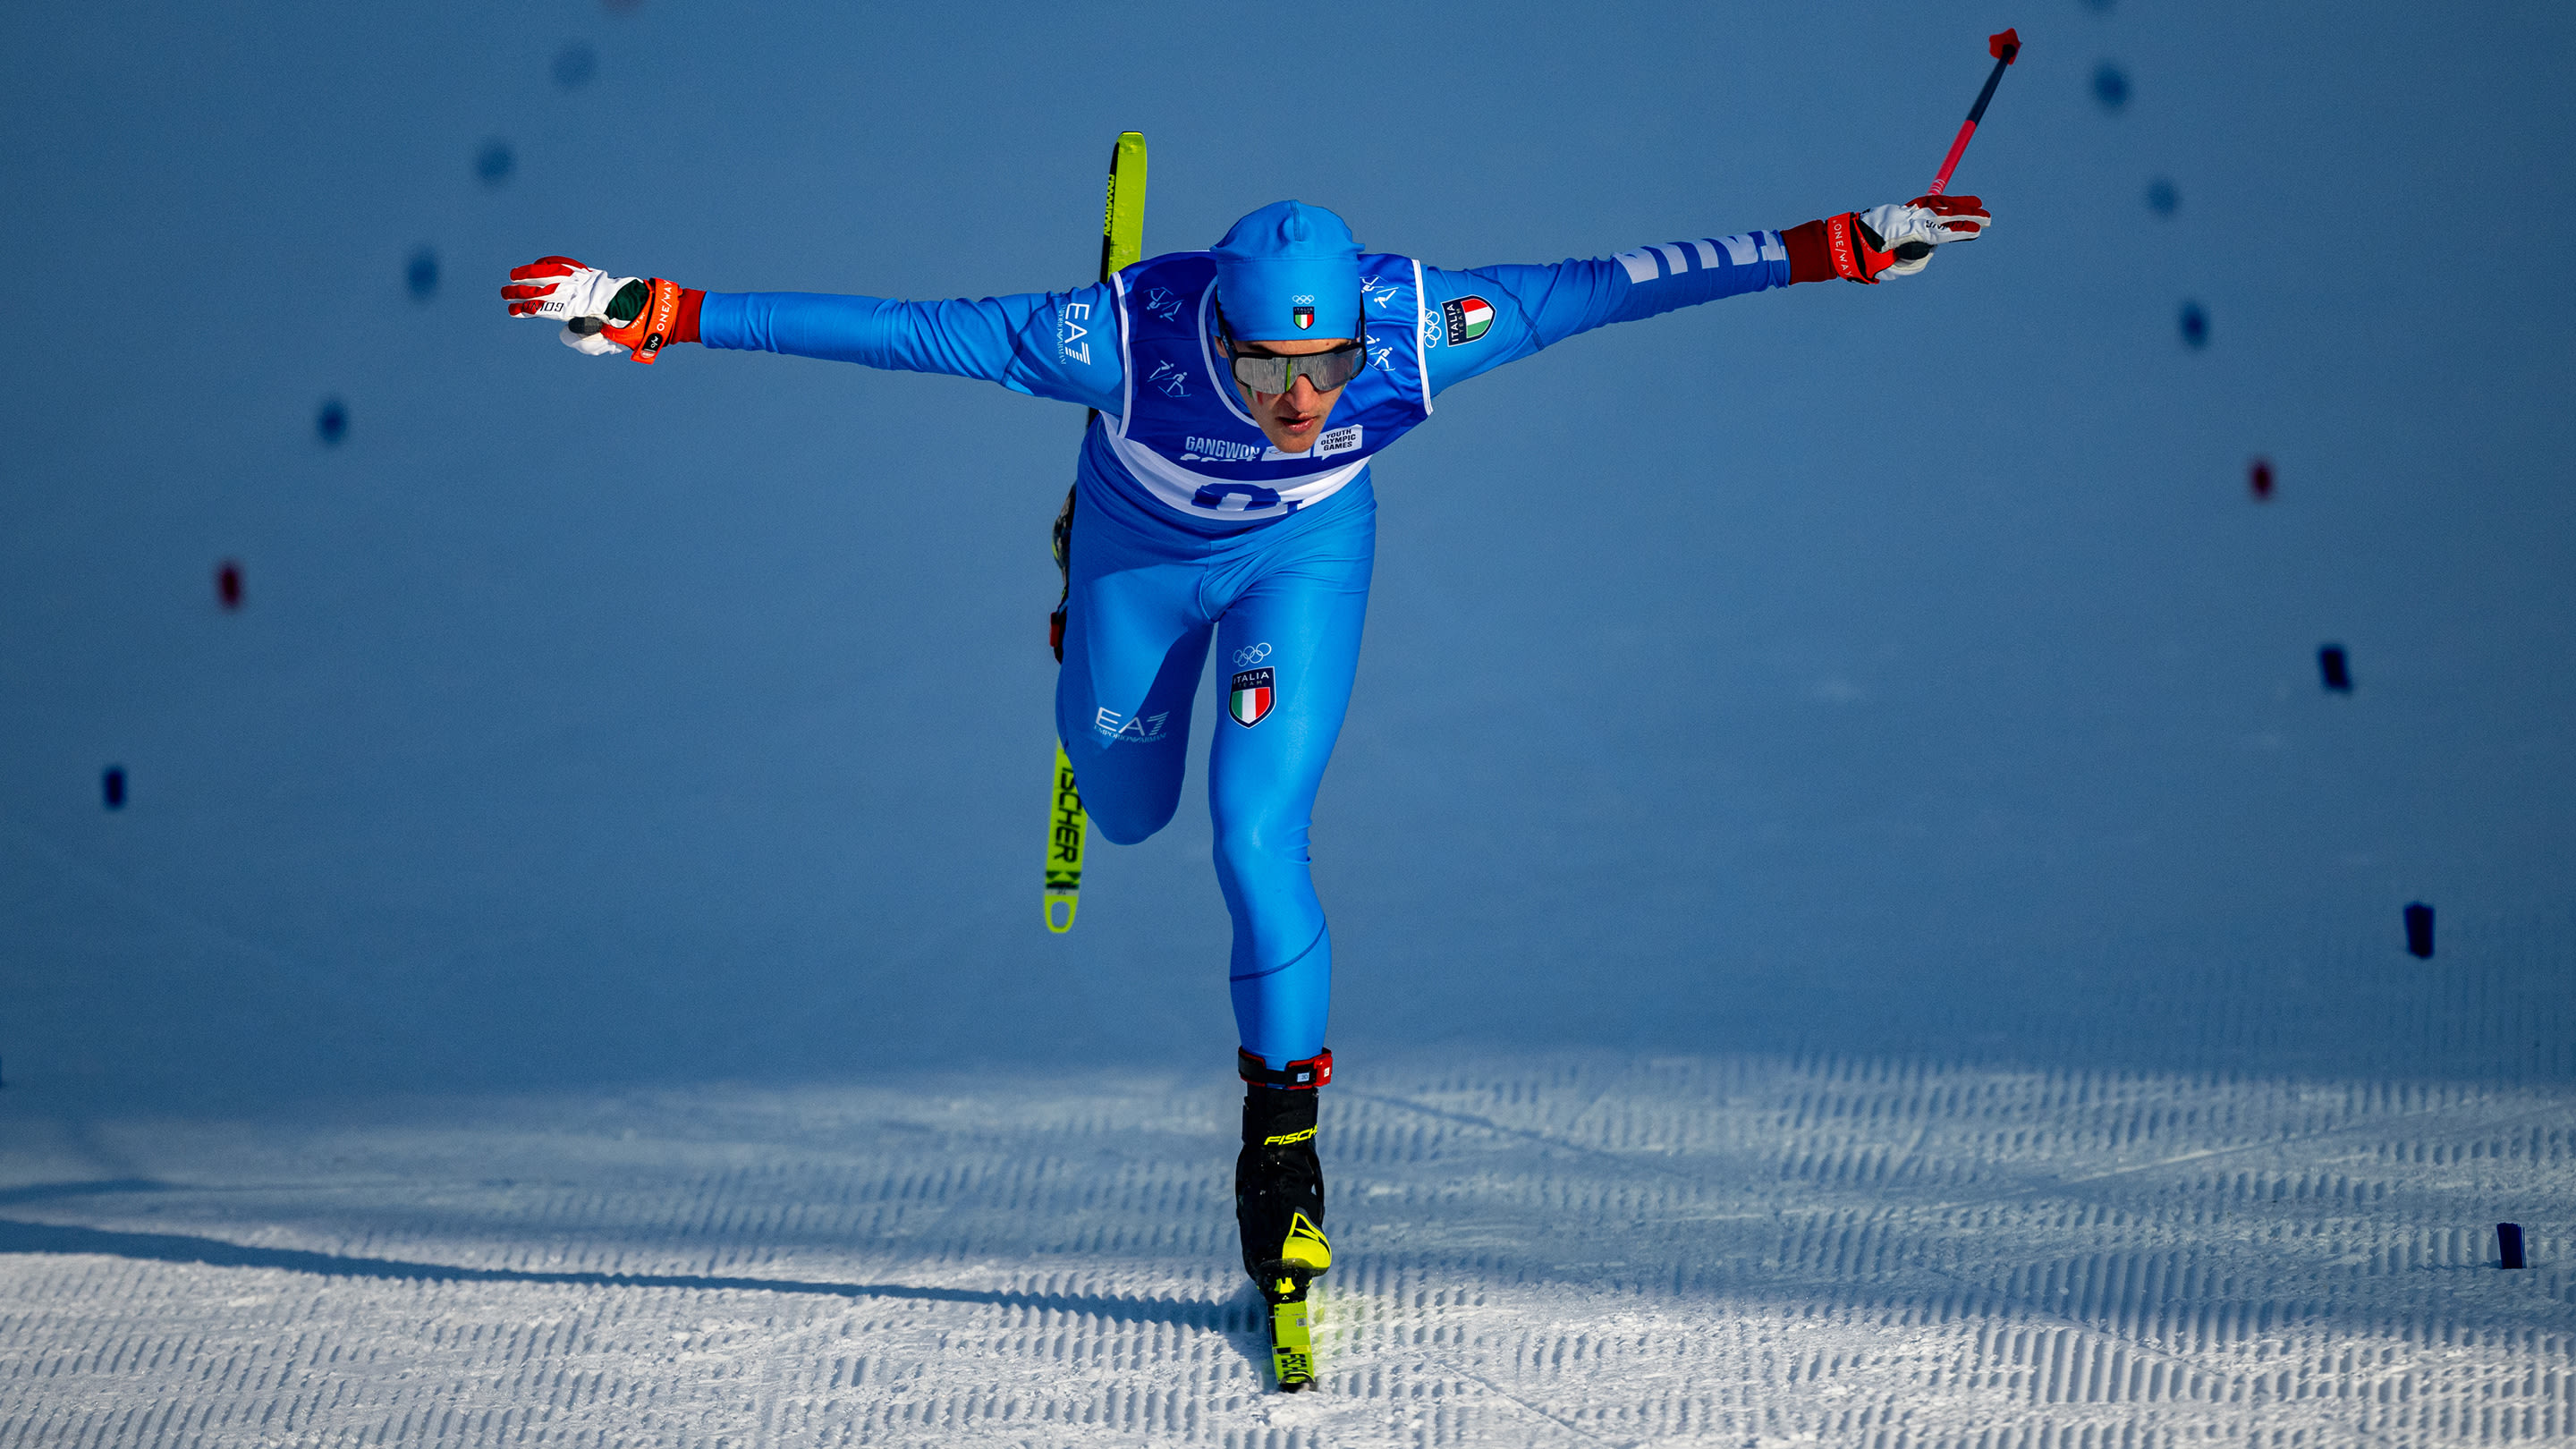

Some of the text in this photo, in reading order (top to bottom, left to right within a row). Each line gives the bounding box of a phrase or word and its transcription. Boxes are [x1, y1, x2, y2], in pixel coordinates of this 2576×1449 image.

[1447, 303, 1459, 343] ITALIA
[1456, 308, 1464, 333] TEAM
[1064, 302, 1090, 365] EA7
[1320, 434, 1356, 445] OLYMPIC
[1326, 428, 1352, 439] YOUTH
[1324, 441, 1352, 451] GAMES
[1233, 671, 1270, 685] ITALIA
[1239, 680, 1263, 688] TEAM
[1096, 707, 1170, 736] EA7
[1055, 767, 1081, 863] ISCHER
[1264, 1123, 1318, 1146] FISCH
